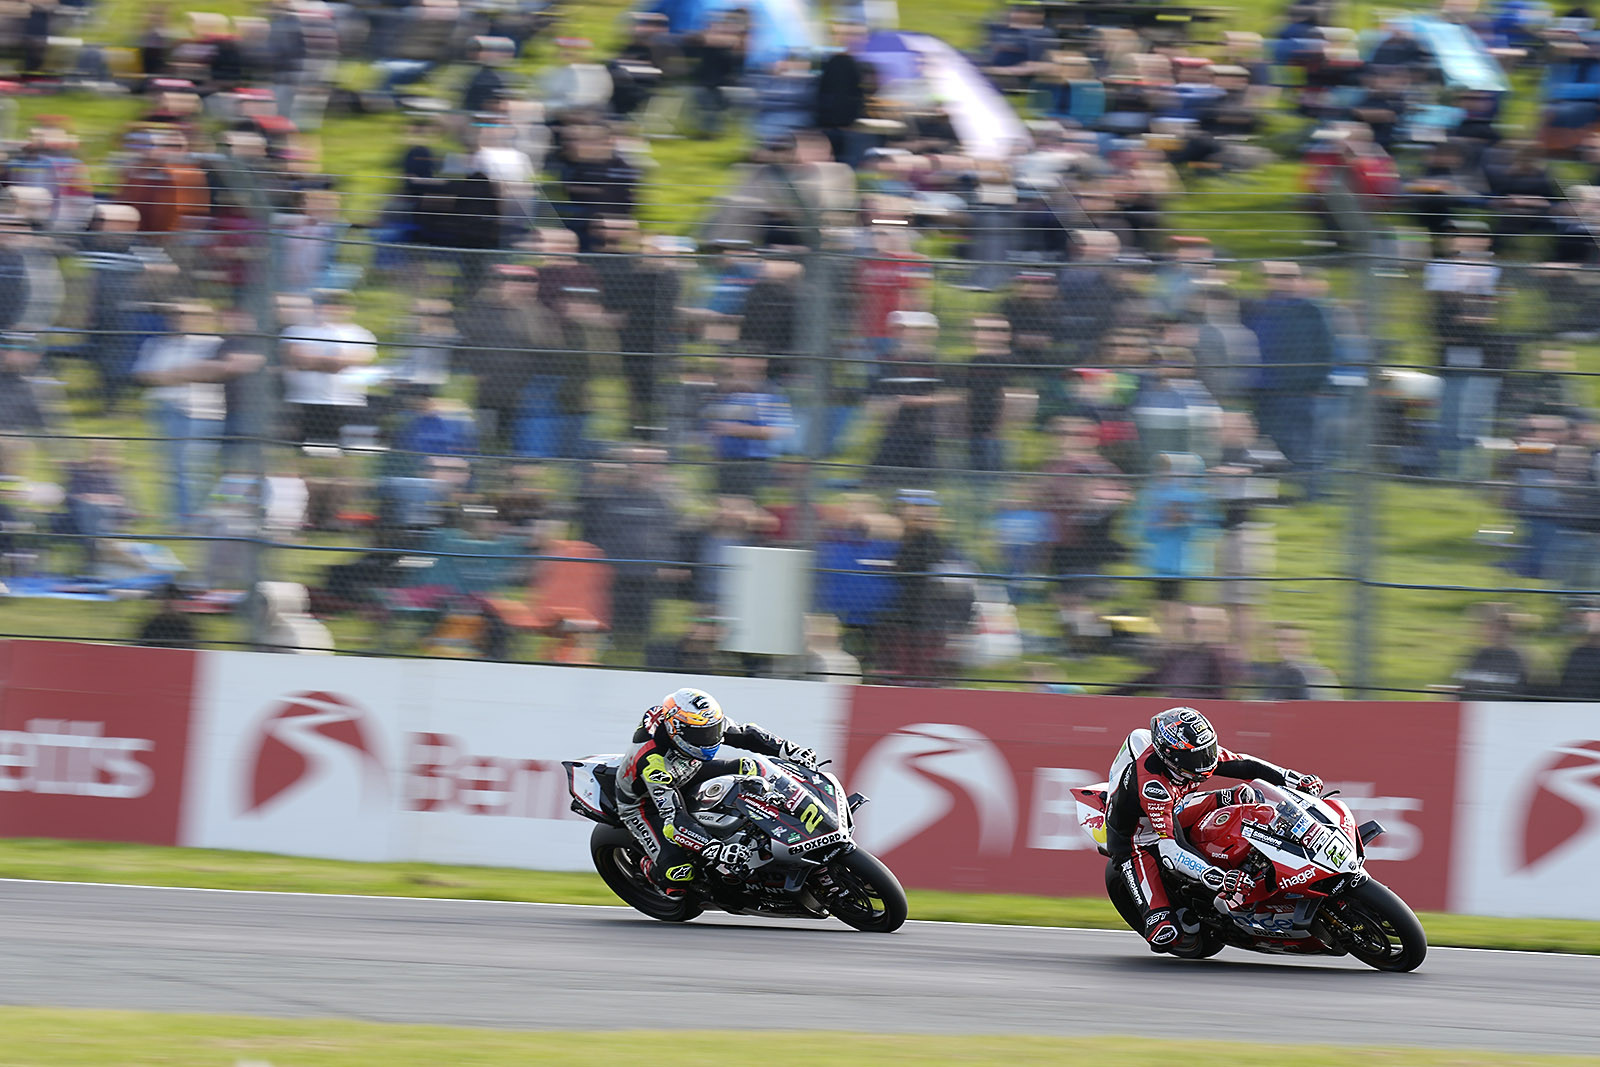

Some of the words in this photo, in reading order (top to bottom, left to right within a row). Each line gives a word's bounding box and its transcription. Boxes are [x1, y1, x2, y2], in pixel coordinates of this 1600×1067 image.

[800, 803, 824, 834] 2
[630, 816, 659, 854] DUCATI
[674, 835, 694, 848] ROCK
[688, 830, 709, 844] OXFORD
[804, 833, 841, 851] OXFORD
[1211, 852, 1229, 860] DUCATI
[1146, 910, 1170, 928] RST
